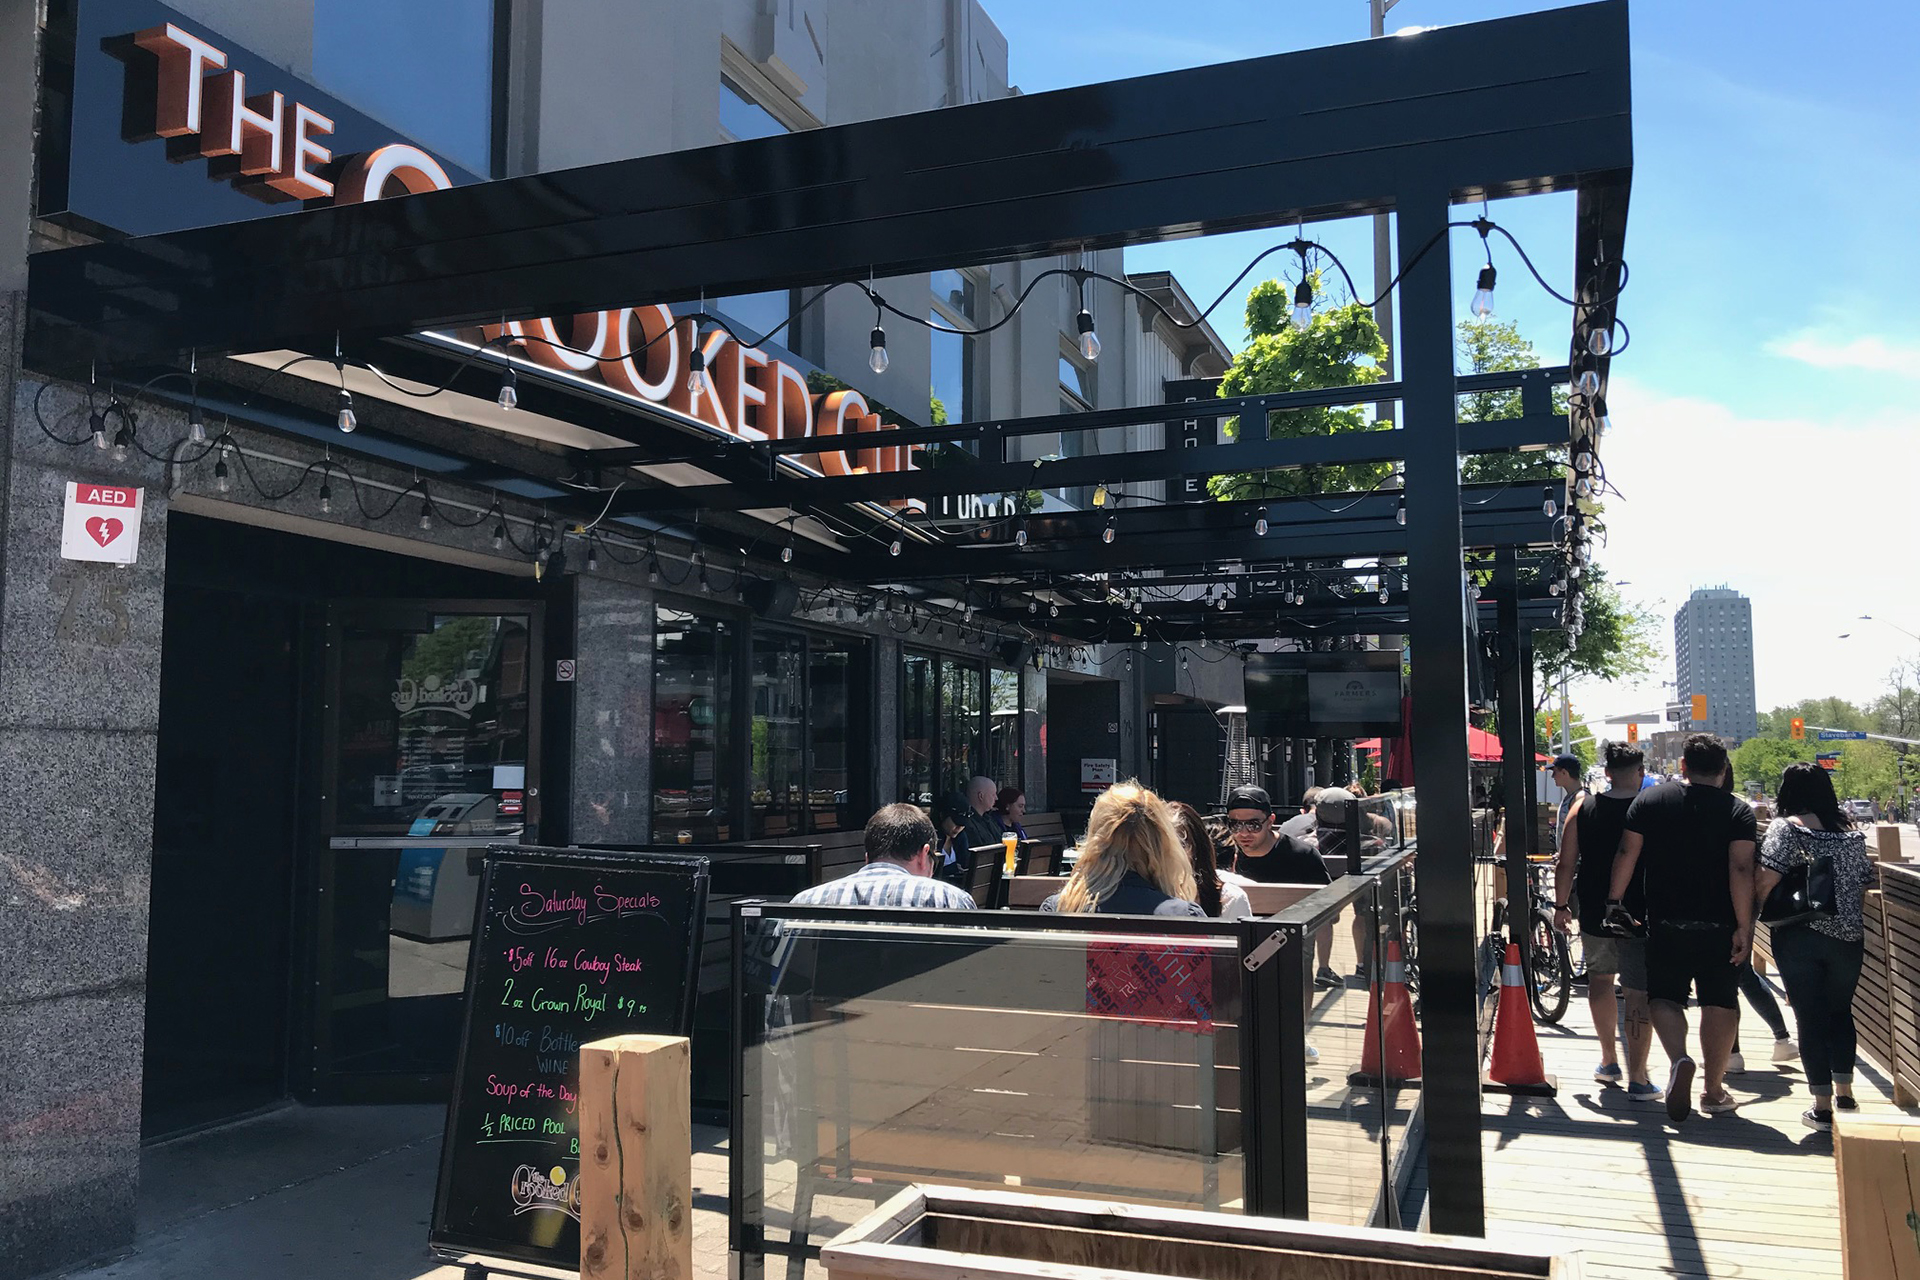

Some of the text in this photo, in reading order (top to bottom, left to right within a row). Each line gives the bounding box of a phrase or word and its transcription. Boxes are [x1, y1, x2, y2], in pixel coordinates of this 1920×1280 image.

[158, 22, 335, 198] THE
[87, 488, 127, 504] AED
[519, 883, 661, 926] Saturday Specials
[574, 948, 611, 985] Cowboy
[614, 953, 642, 972] Steak
[501, 978, 515, 1006] 2
[512, 1000, 524, 1009] oz
[531, 987, 569, 1013] Crown
[573, 983, 607, 1022] Royal
[536, 1055, 569, 1075] WINE
[486, 1074, 578, 1114] Soup of the Day
[499, 1113, 536, 1134] PRICED
[542, 1117, 567, 1135] POOL
[511, 1163, 570, 1206] Crooked
